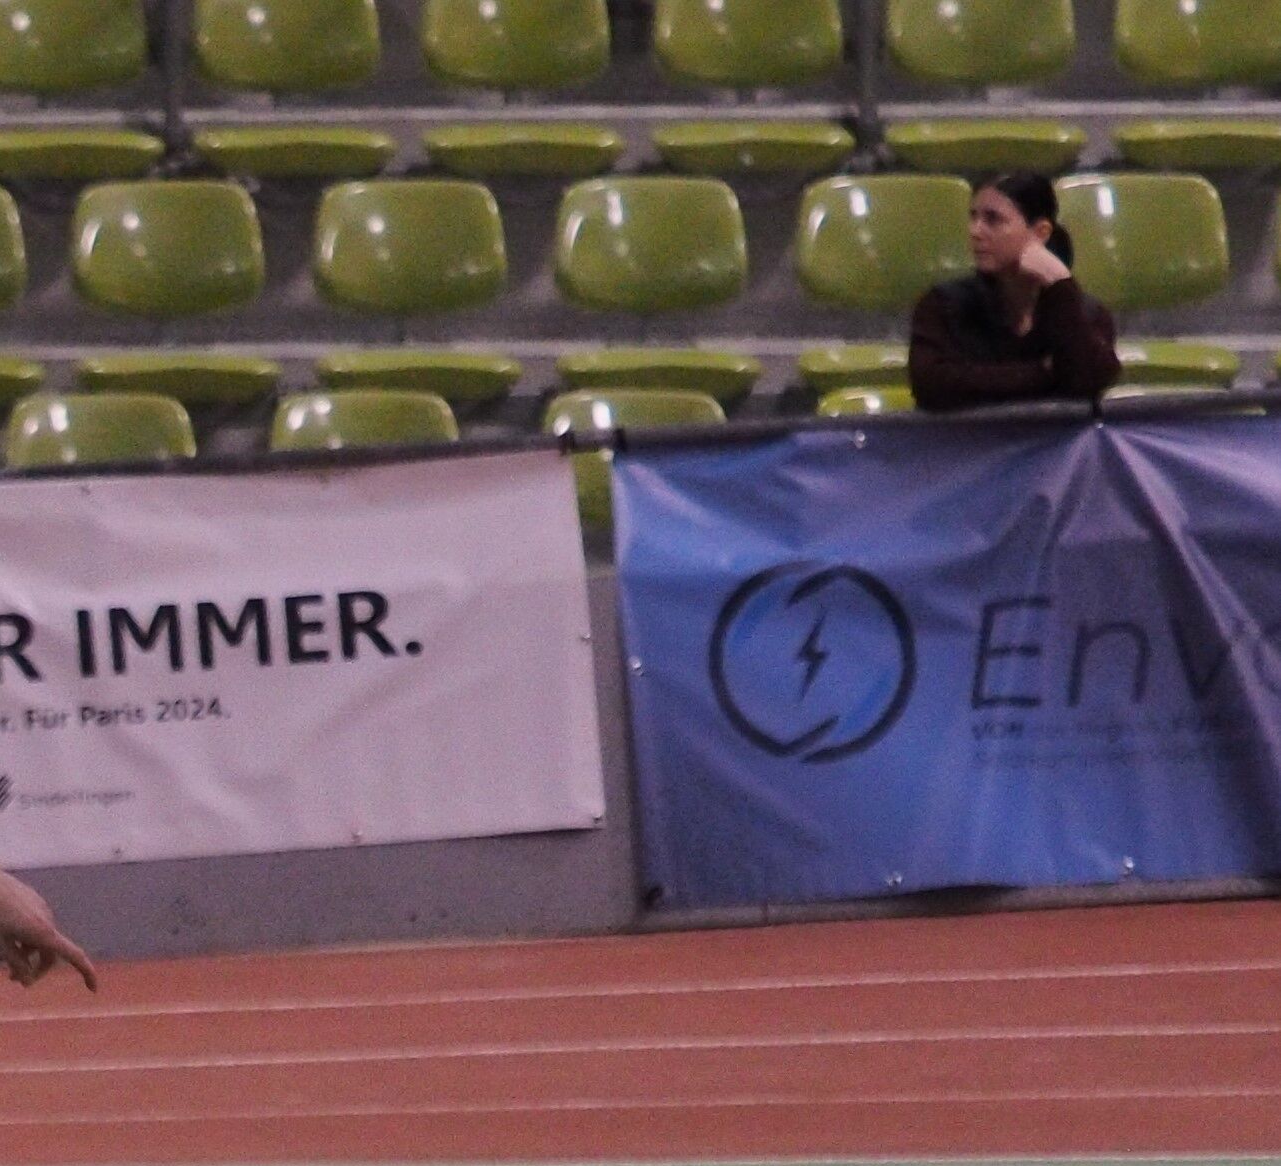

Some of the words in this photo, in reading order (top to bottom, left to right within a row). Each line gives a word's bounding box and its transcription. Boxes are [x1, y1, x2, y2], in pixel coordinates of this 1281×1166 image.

[76, 590, 423, 677] IMMER.
[24, 708, 69, 730] Für
[79, 705, 148, 727] Paris
[156, 698, 231, 723] 2024.
